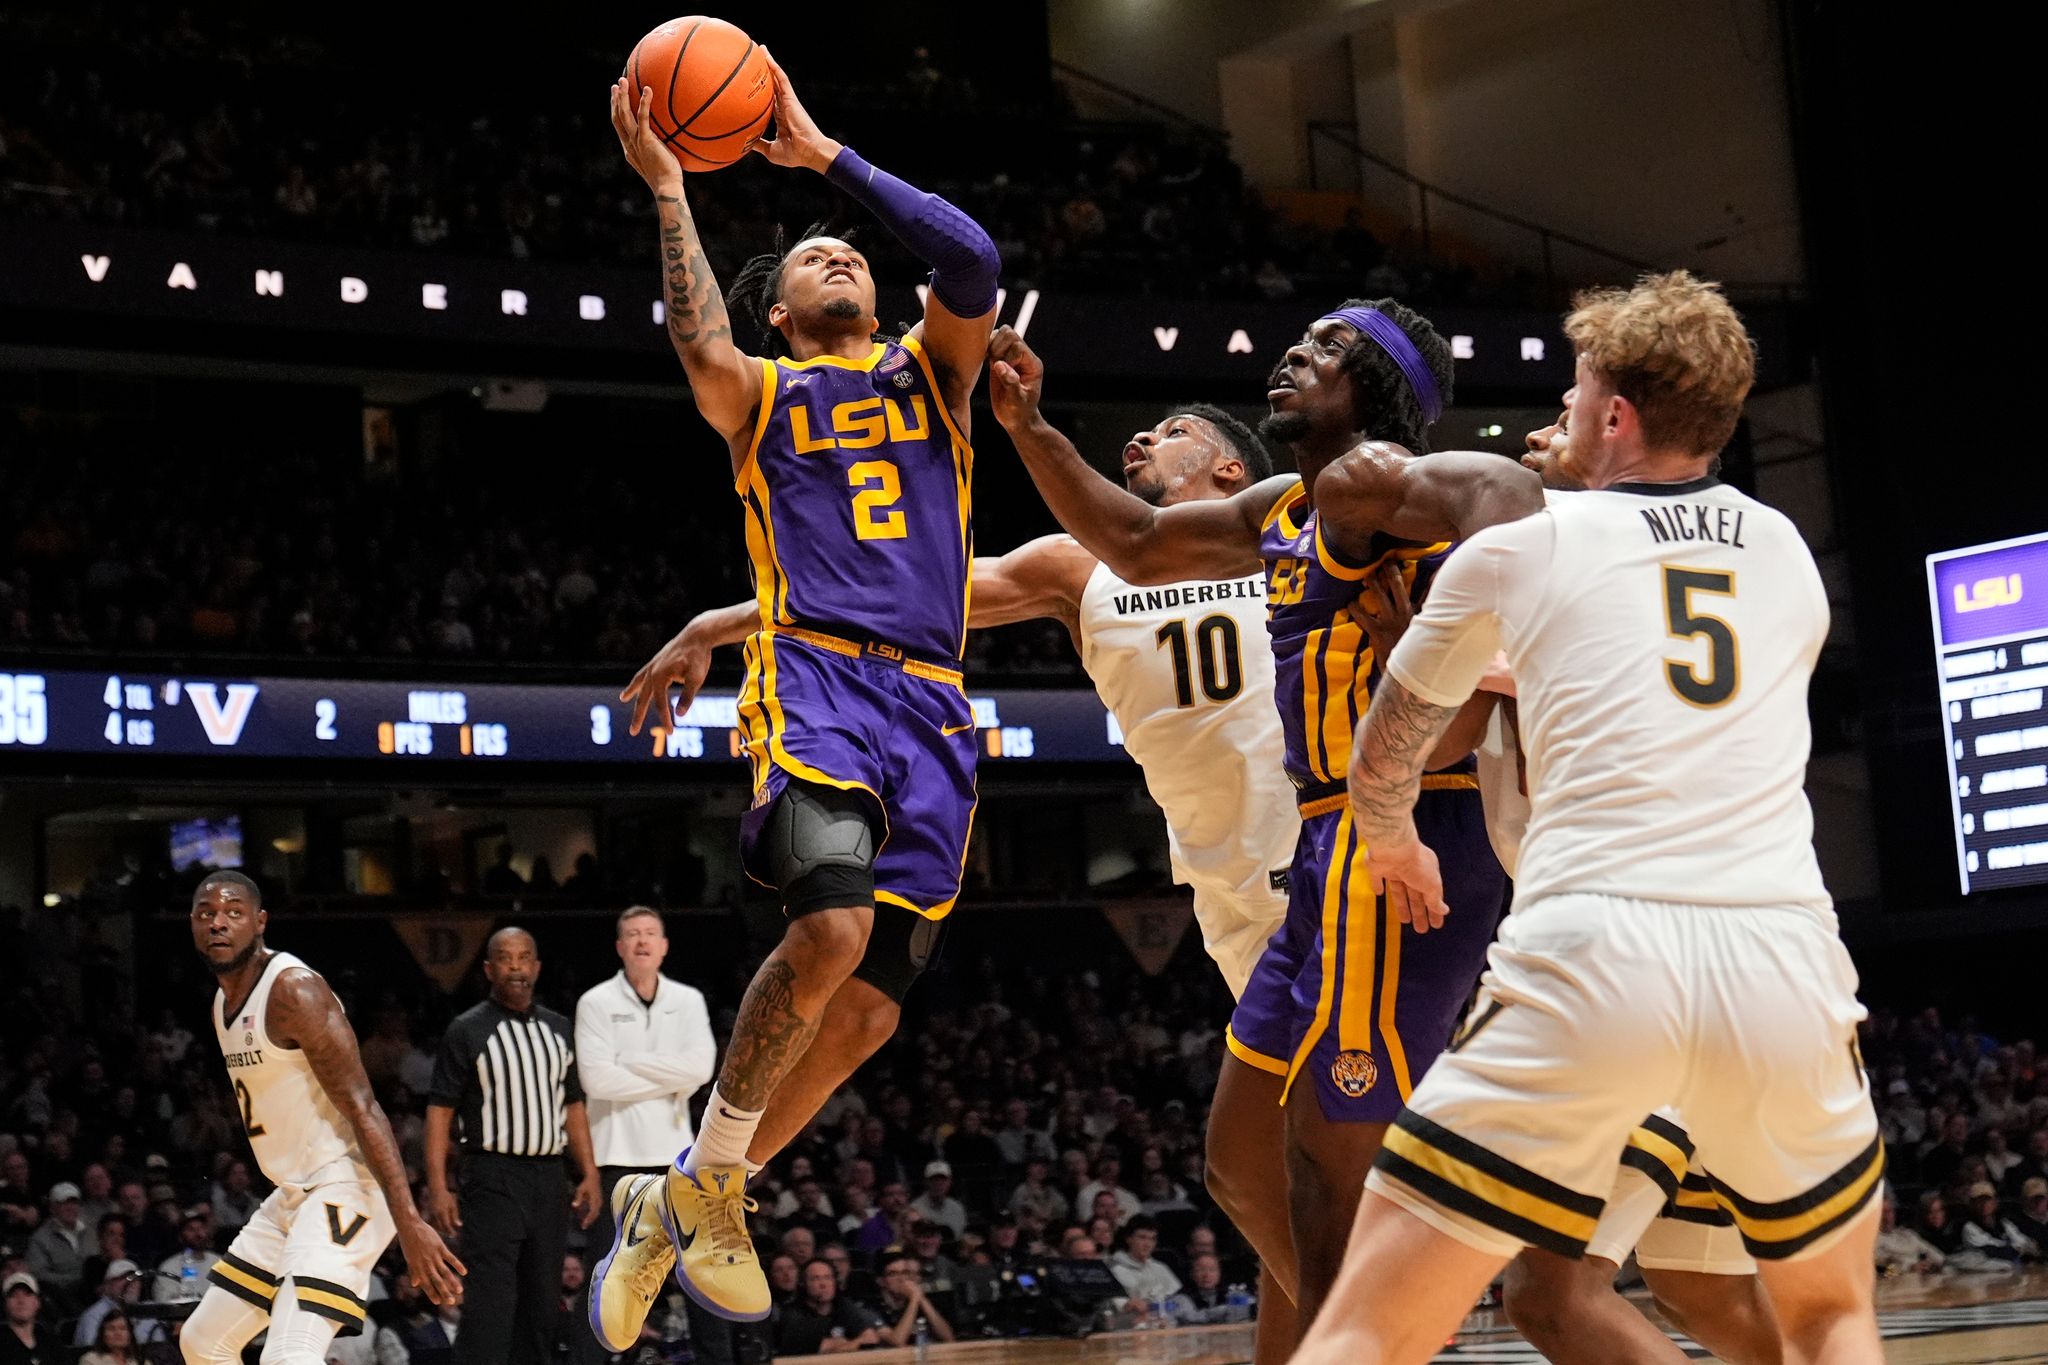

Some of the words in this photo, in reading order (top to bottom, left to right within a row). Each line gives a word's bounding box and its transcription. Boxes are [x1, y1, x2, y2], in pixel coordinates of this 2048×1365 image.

[788, 394, 931, 455] LSU
[848, 460, 908, 541] 2
[1640, 504, 1745, 549] NICKEL
[1113, 580, 1267, 615] VANDERBIL
[1953, 573, 2023, 613] LSU
[867, 641, 903, 661] LSU
[1660, 560, 1742, 711] 5
[1155, 611, 1244, 709] 10
[315, 698, 337, 740] 2
